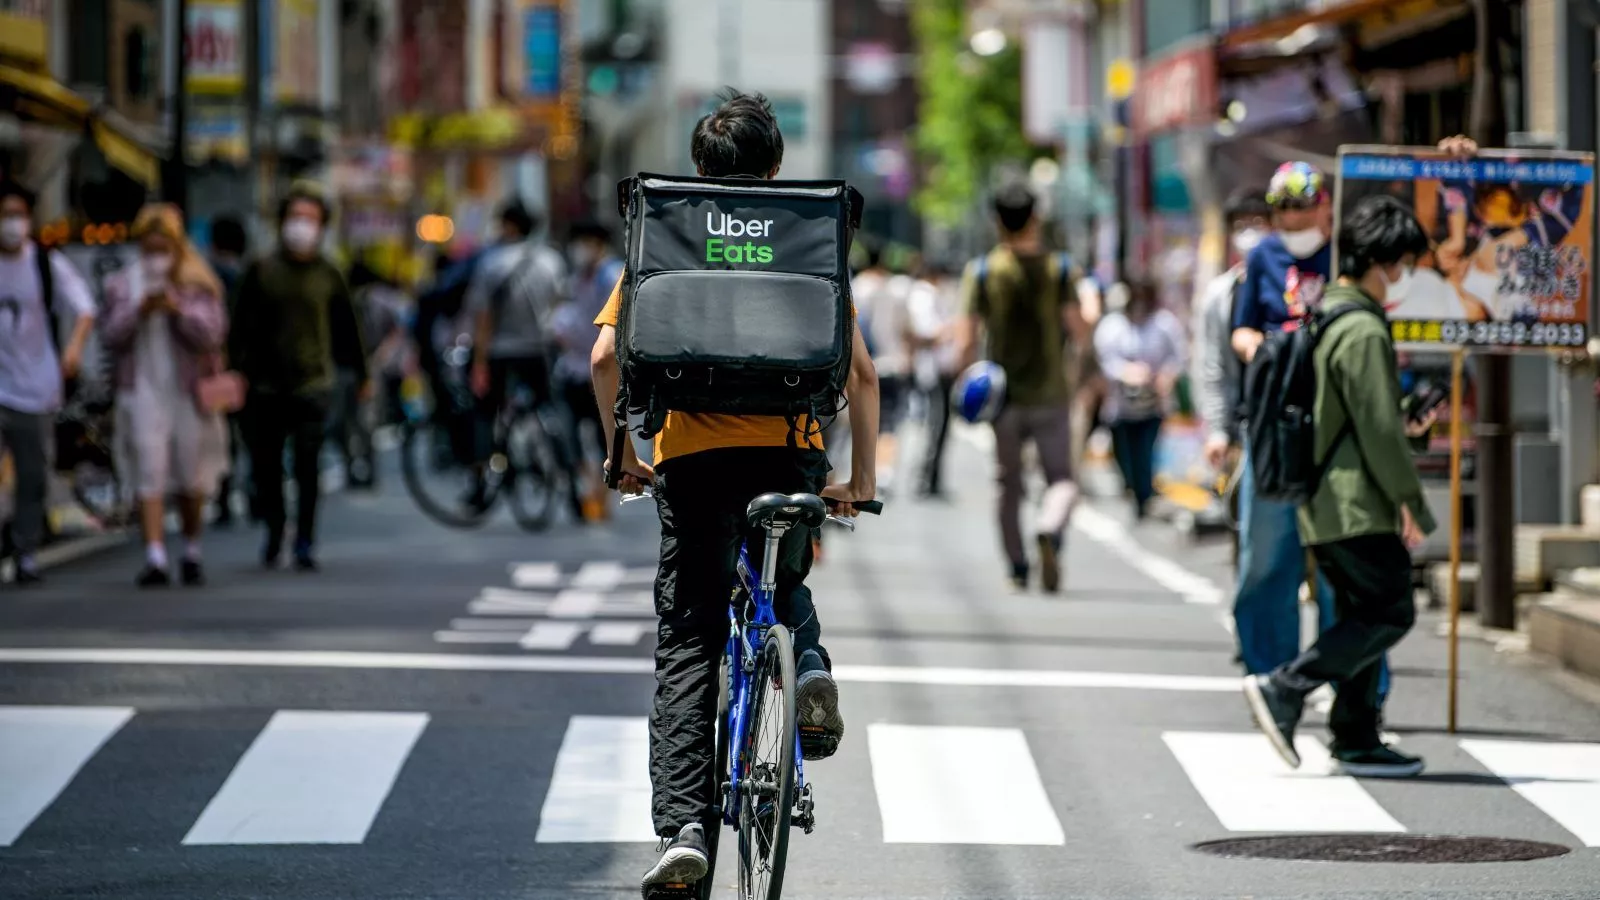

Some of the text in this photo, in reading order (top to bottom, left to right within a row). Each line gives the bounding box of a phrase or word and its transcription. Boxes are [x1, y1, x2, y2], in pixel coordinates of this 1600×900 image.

[706, 212, 774, 237] Uber
[706, 238, 774, 263] Eats
[1442, 321, 1584, 344] 03-3252-2033
